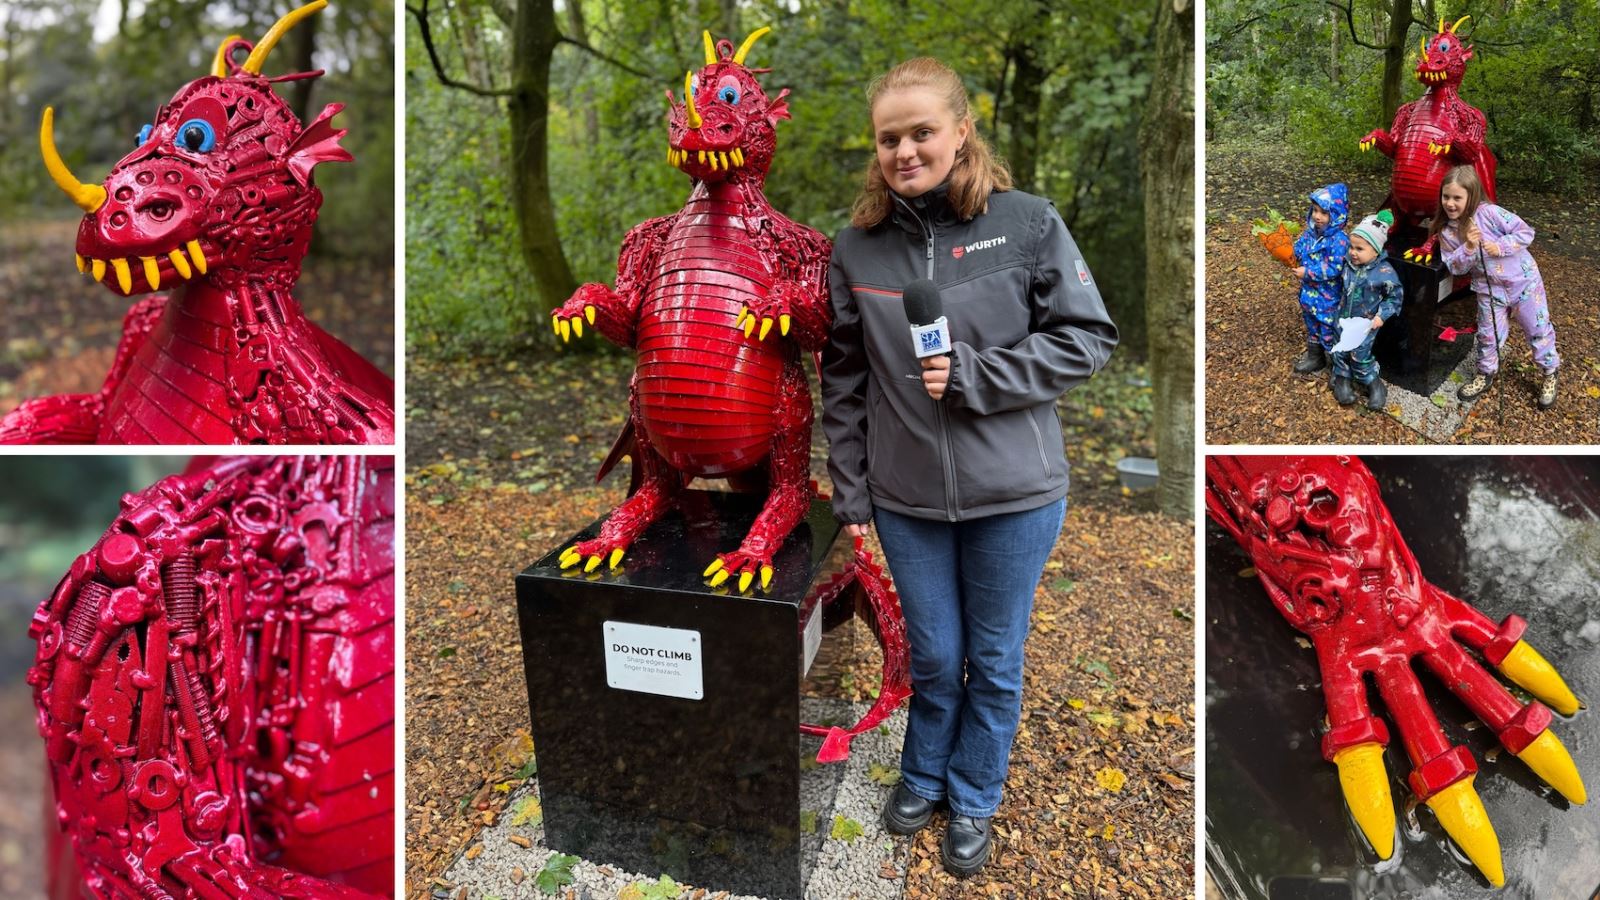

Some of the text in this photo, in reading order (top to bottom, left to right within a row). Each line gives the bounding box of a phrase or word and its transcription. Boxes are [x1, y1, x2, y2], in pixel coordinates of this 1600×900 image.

[965, 236, 1006, 253] WURTH
[613, 644, 692, 661] DO NOT CLIMB
[624, 663, 642, 672] finger
[642, 666, 655, 674] trap
[646, 659, 665, 667] edges
